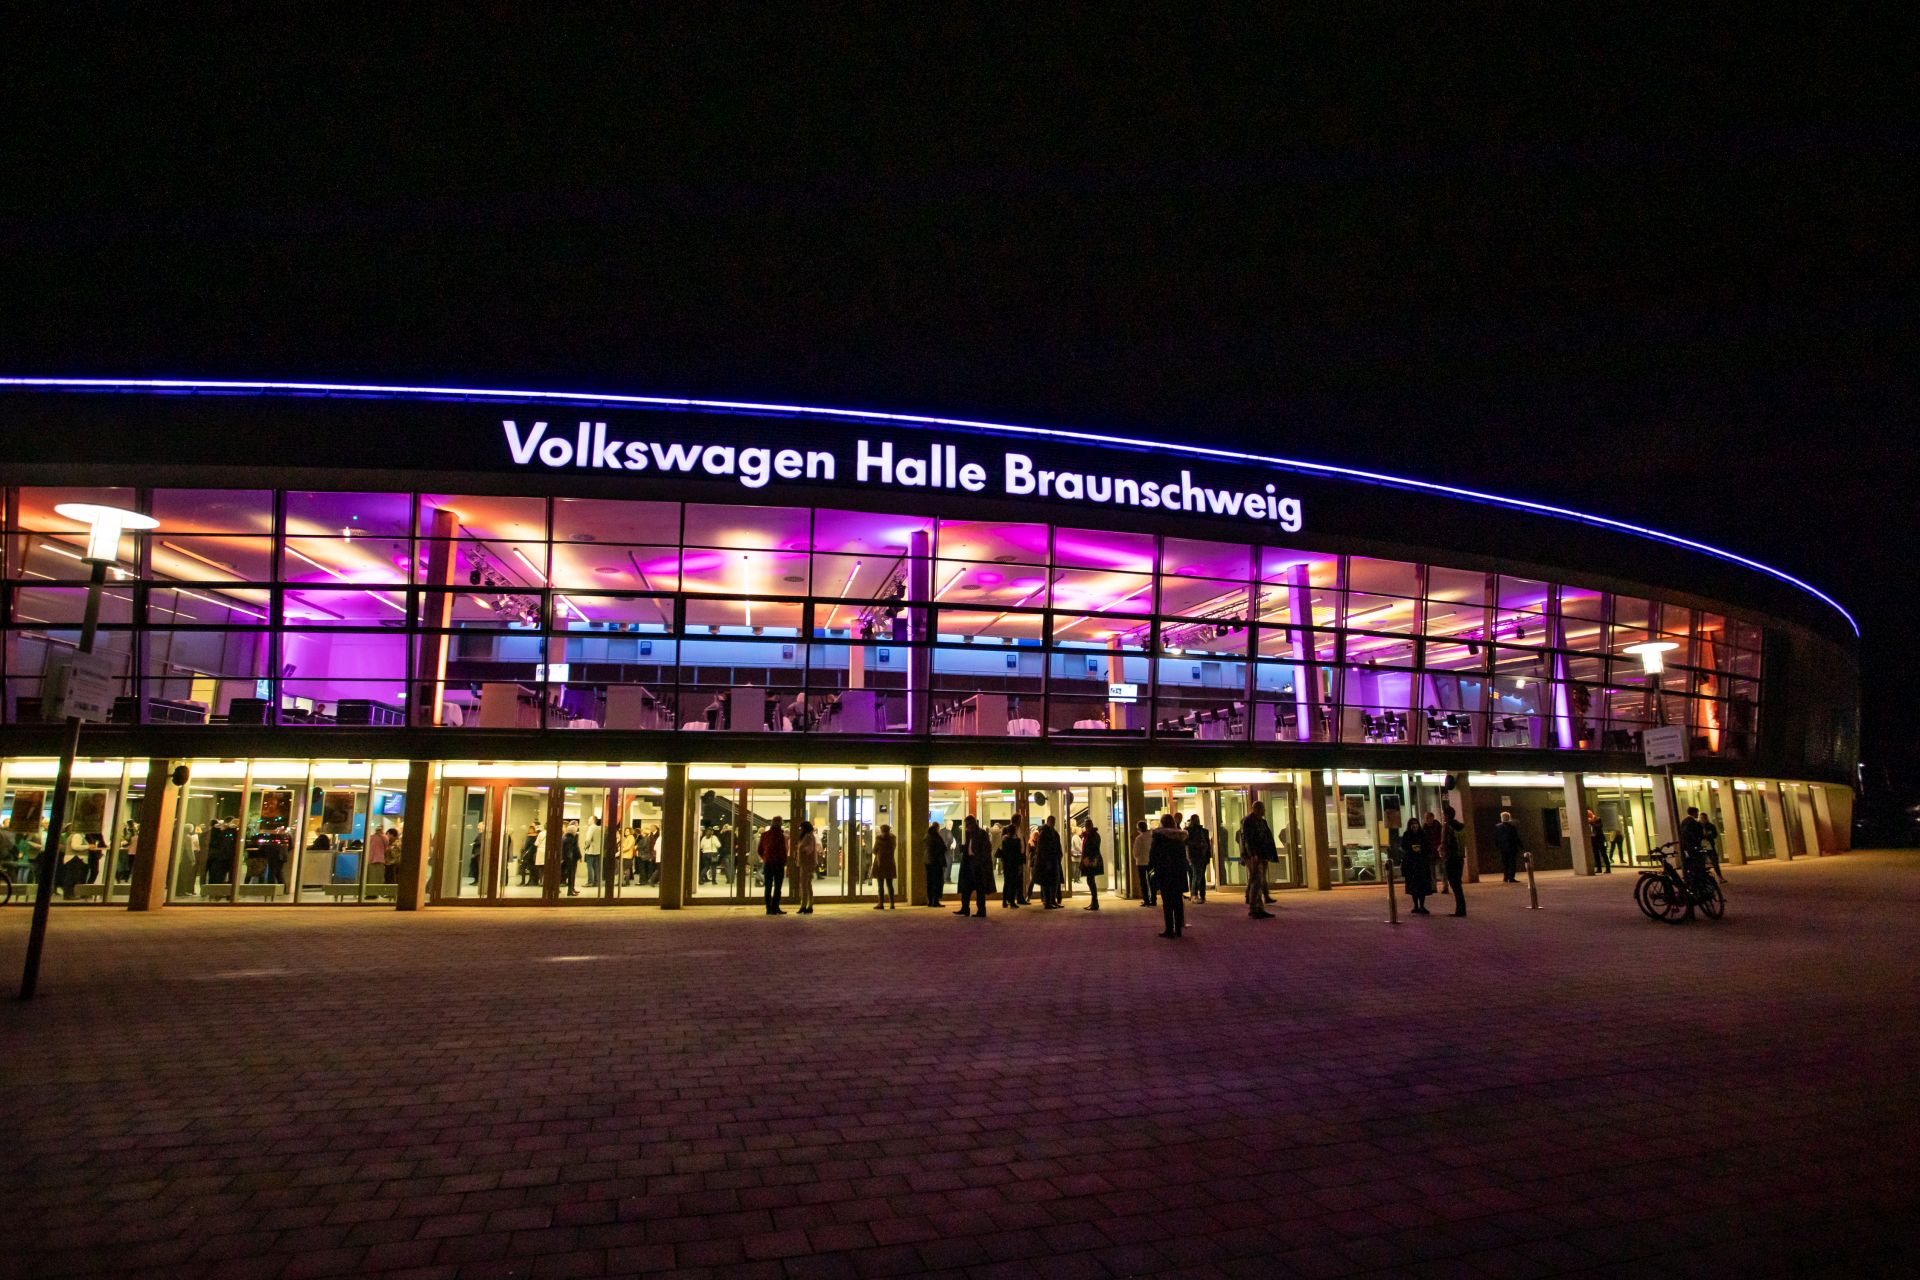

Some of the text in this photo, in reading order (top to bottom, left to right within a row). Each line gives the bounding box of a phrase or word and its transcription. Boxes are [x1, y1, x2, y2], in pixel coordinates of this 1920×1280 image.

[502, 420, 1302, 532] Volkswagen Halle Braunschweig
